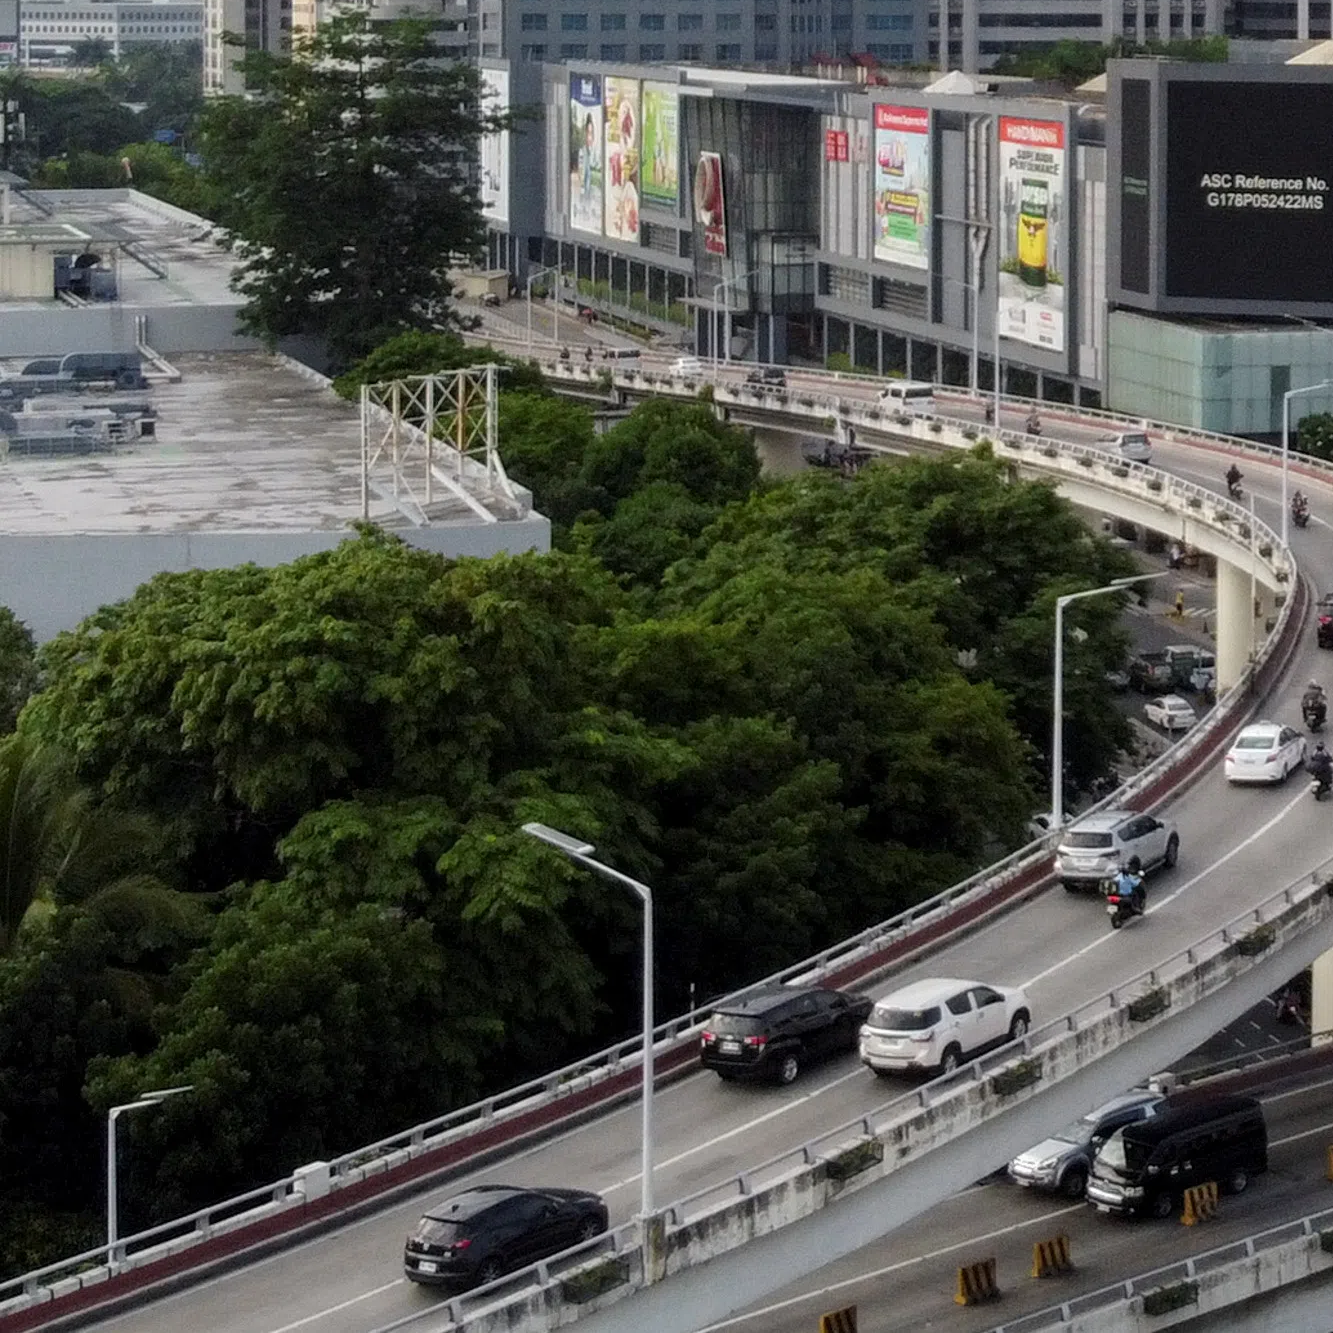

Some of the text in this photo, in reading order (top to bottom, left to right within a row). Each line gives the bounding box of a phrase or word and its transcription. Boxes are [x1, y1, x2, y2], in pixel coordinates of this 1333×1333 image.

[1201, 174, 1330, 191] ASC Reference No.
